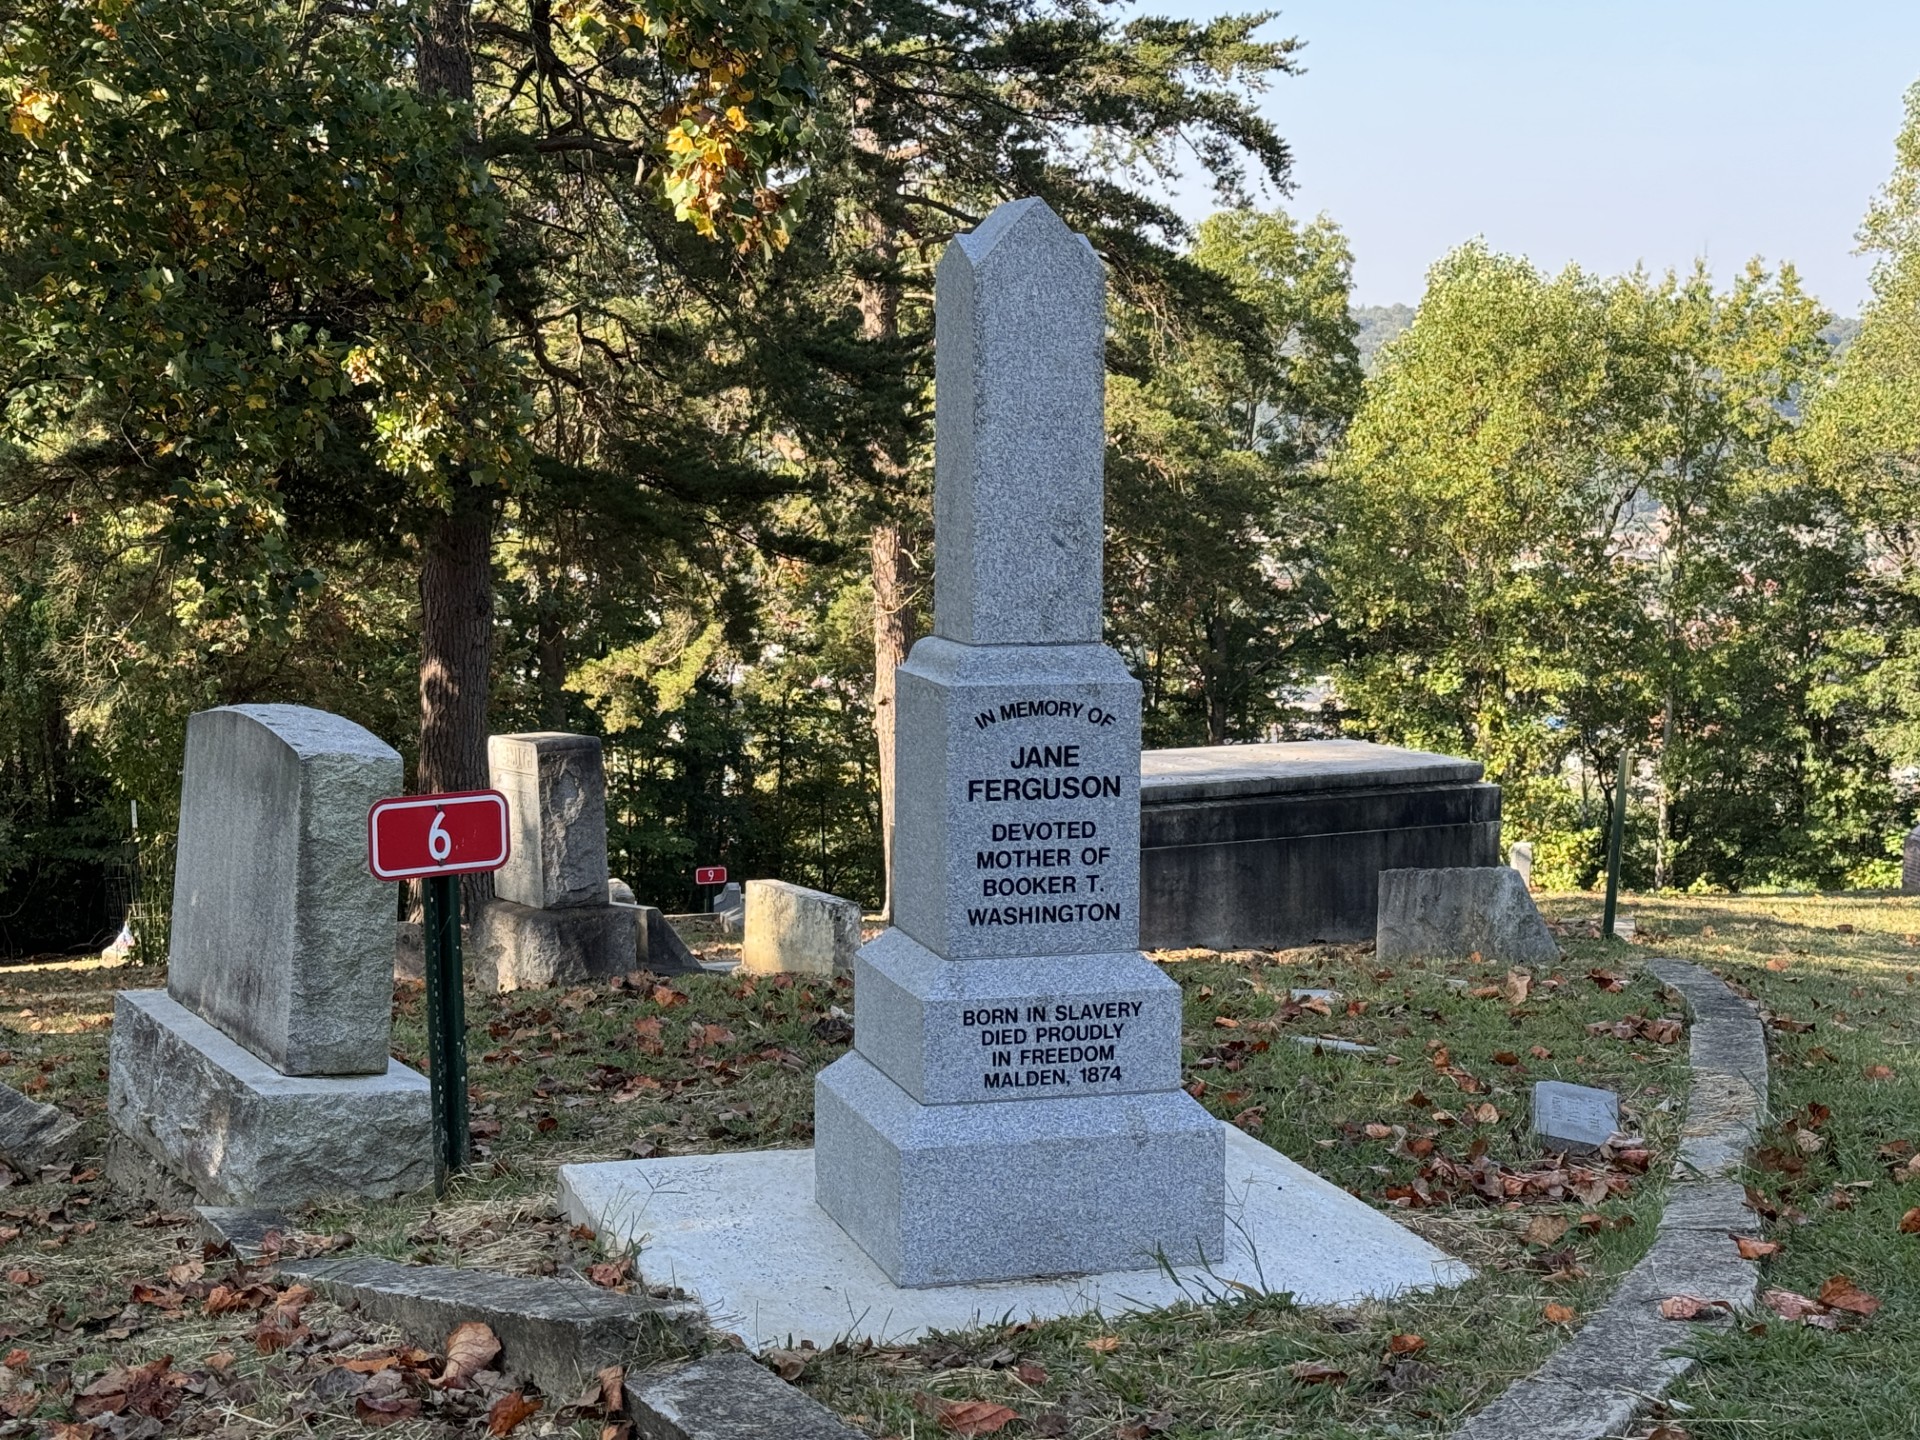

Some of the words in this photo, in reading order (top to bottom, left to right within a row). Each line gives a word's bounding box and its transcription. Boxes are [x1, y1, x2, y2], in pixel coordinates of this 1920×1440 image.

[974, 709, 996, 730] IN
[1000, 700, 1084, 721] MEMORY
[1087, 707, 1116, 728] OF
[1010, 745, 1080, 769] JANE
[968, 775, 1121, 801] FERGUSON
[428, 810, 452, 862] 6
[992, 821, 1096, 842] DEVOTED
[976, 849, 1071, 870] MOTHER
[1081, 847, 1110, 866] OF
[707, 869, 715, 881] 9
[983, 875, 1077, 897] BOOKER
[1086, 874, 1105, 893] T.
[967, 903, 1121, 926] WASHINGTON
[962, 1007, 1019, 1026] BORN
[1027, 1006, 1046, 1022] IN
[1054, 1001, 1143, 1022] SLAVERY
[981, 1028, 1027, 1046] DIED
[1035, 1022, 1125, 1044] PROUDLY
[992, 1050, 1012, 1067] IN
[1019, 1044, 1116, 1066] FREEDOM
[983, 1069, 1071, 1089] MALDEN,
[1079, 1065, 1123, 1083] 1874
